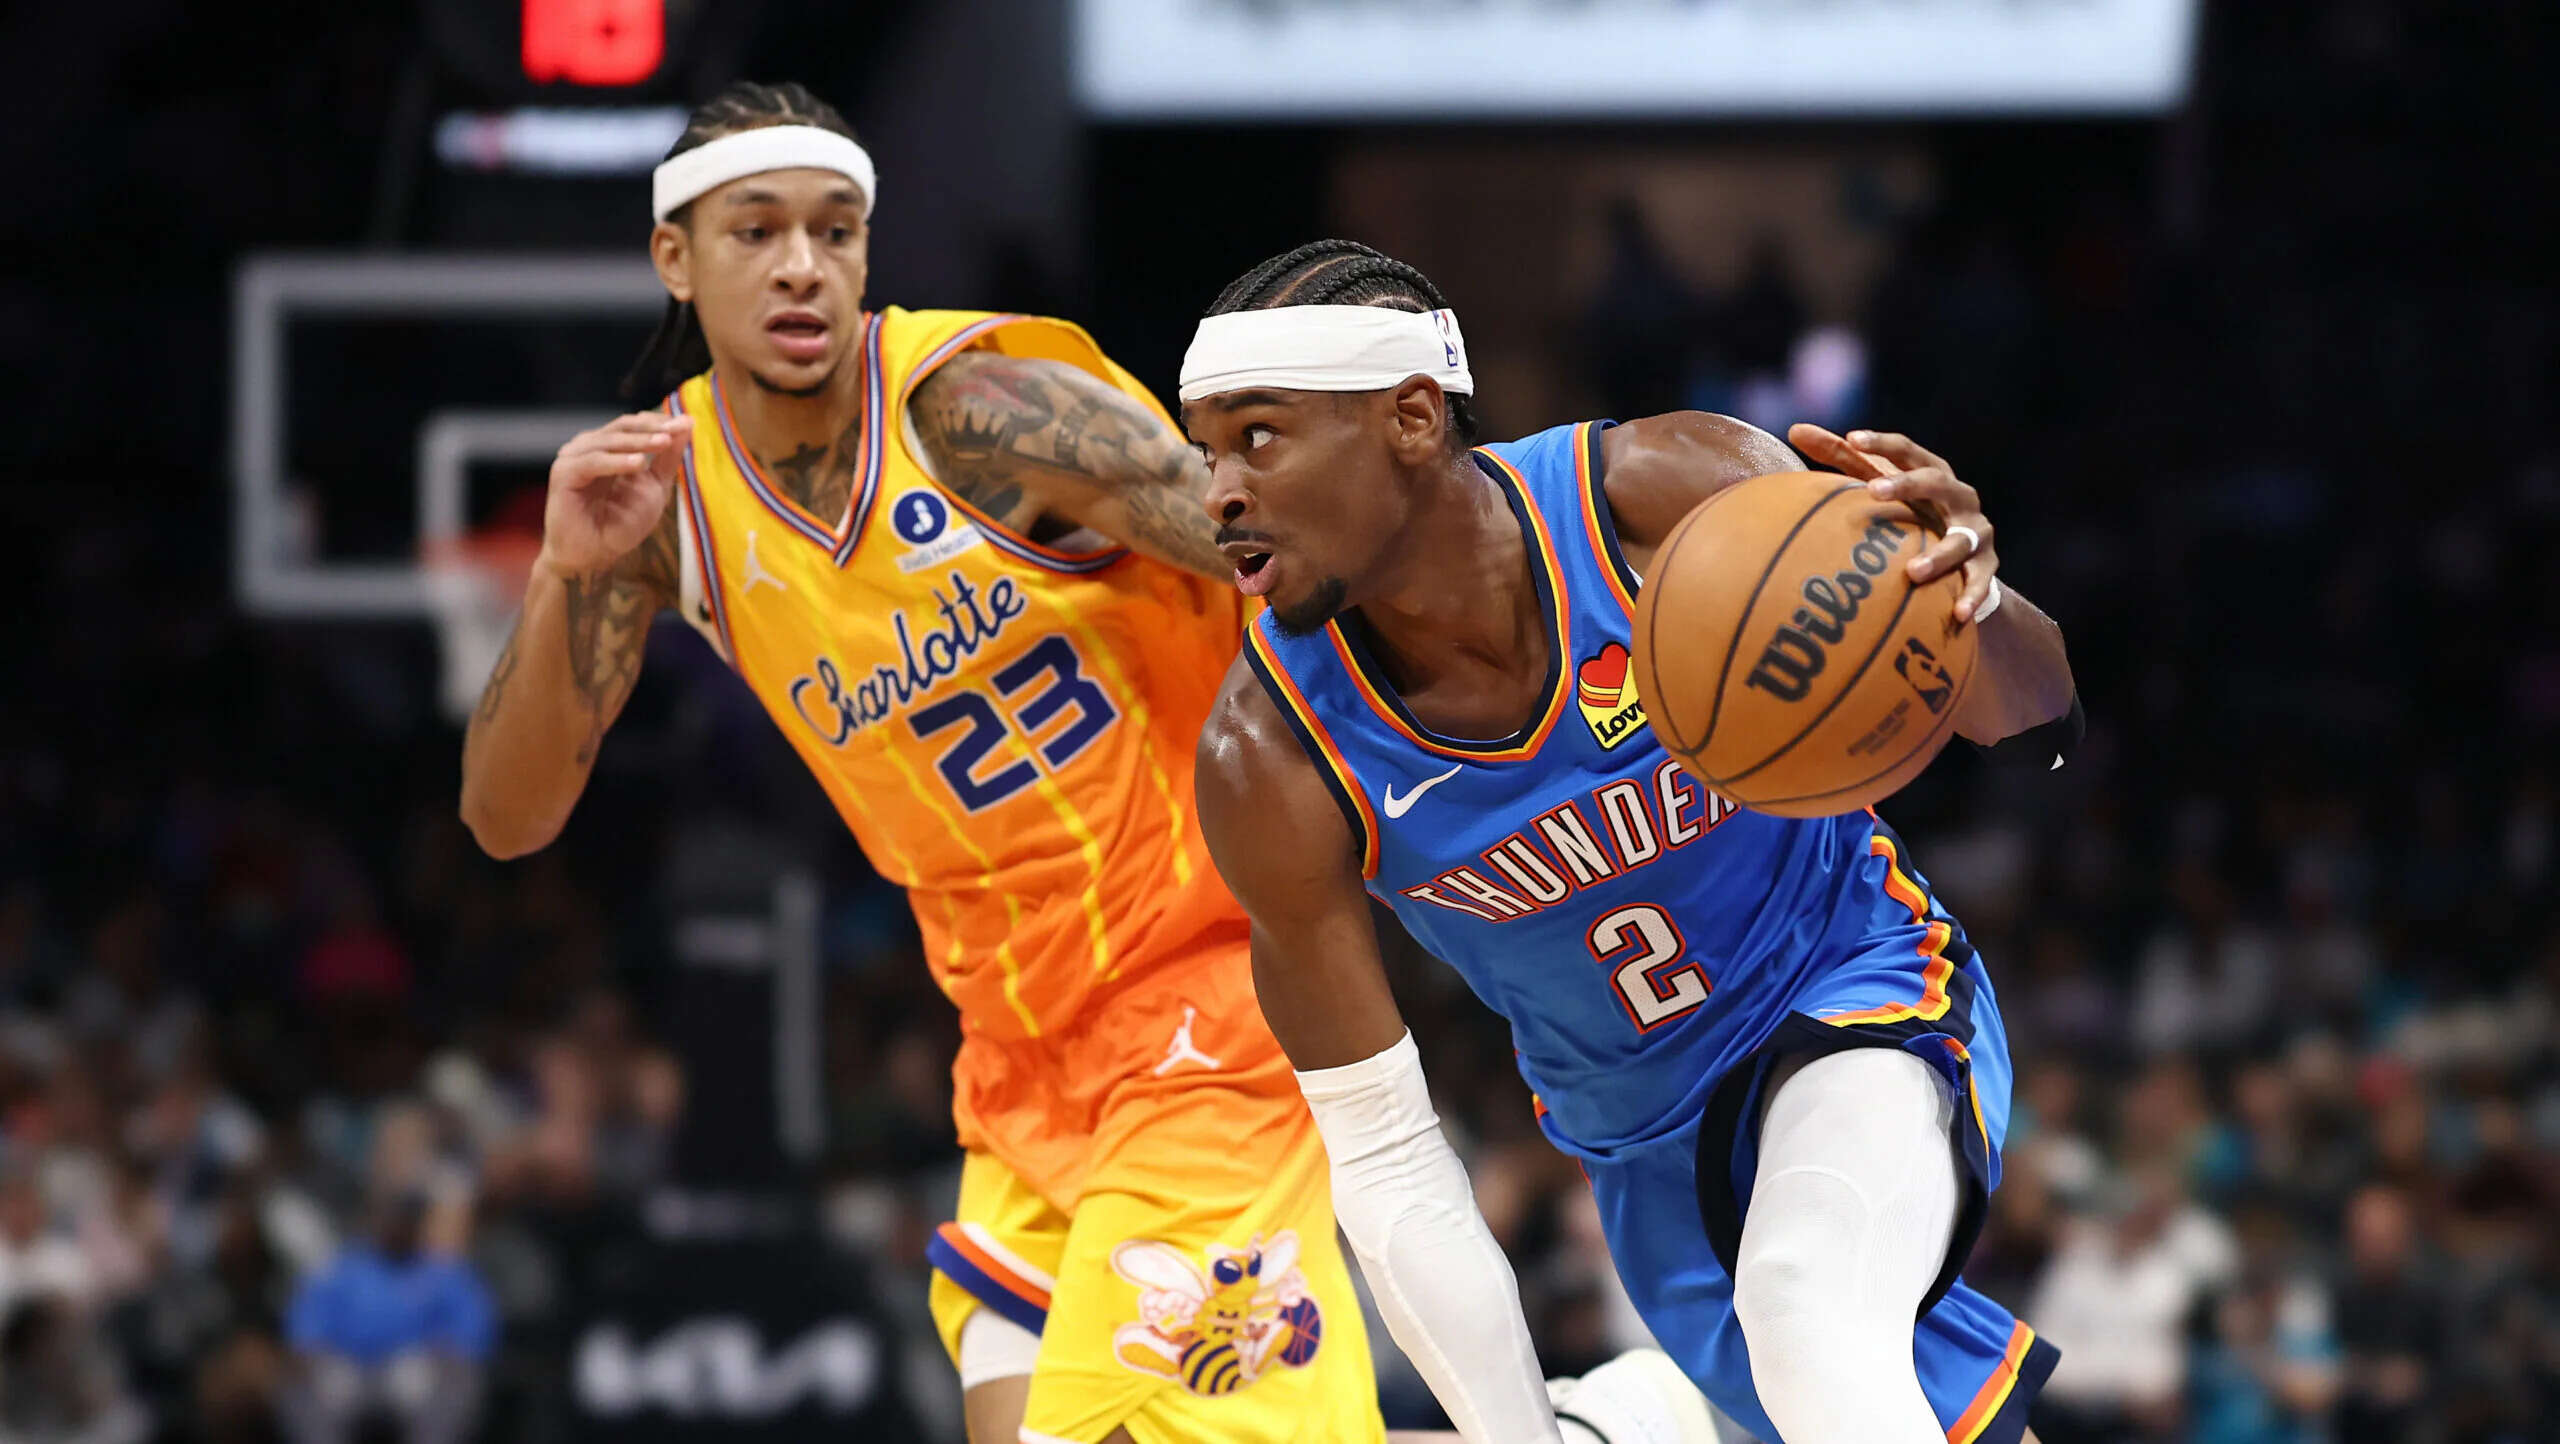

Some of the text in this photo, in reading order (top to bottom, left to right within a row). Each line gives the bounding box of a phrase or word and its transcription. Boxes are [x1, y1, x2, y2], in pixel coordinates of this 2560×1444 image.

[789, 570, 1027, 747] Charlotte
[1744, 515, 1909, 704] Wilson
[906, 633, 1121, 816] 23
[1585, 902, 1713, 1035] 2
